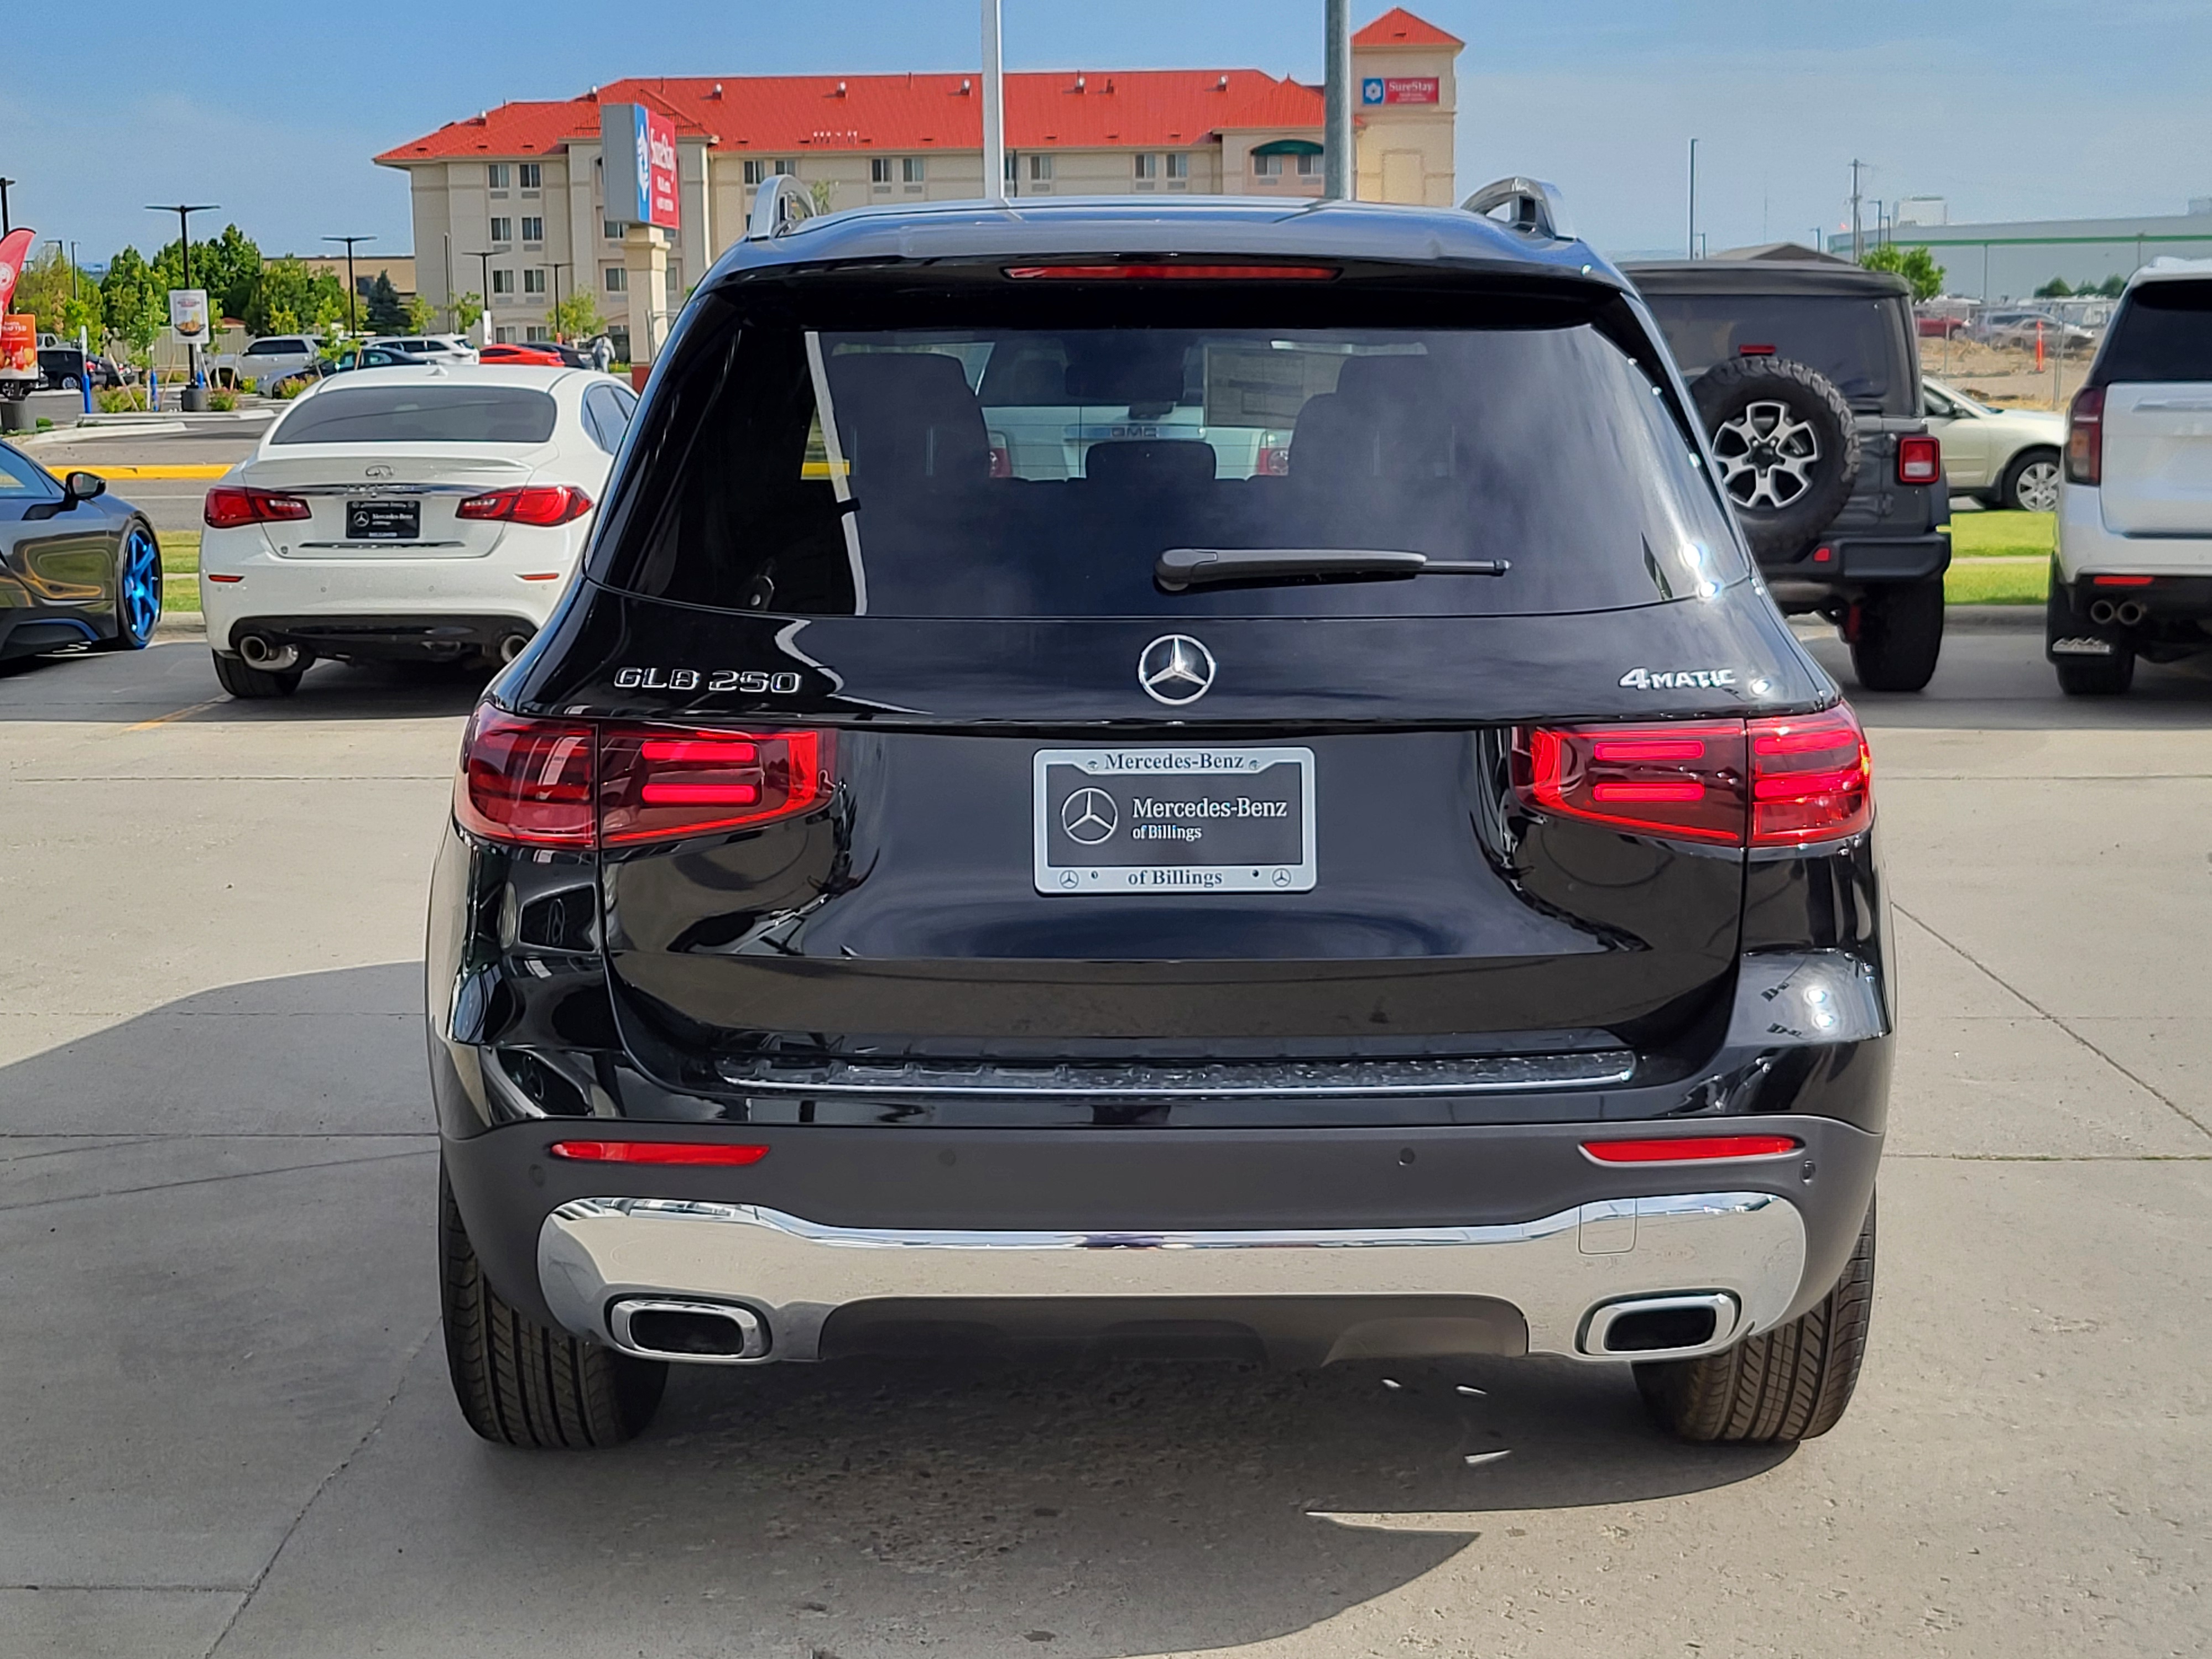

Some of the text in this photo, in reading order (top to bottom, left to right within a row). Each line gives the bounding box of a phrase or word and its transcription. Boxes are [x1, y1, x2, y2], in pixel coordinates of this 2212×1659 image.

[1389, 81, 1433, 93] SureStay
[614, 667, 801, 693] GLB 250
[1619, 667, 1736, 690] 4MATIC
[1104, 753, 1244, 770] Mercedes-Benz
[1133, 797, 1287, 818] Mercedes-Benz
[1133, 825, 1202, 842] of Billings
[1128, 869, 1222, 888] of Billings
